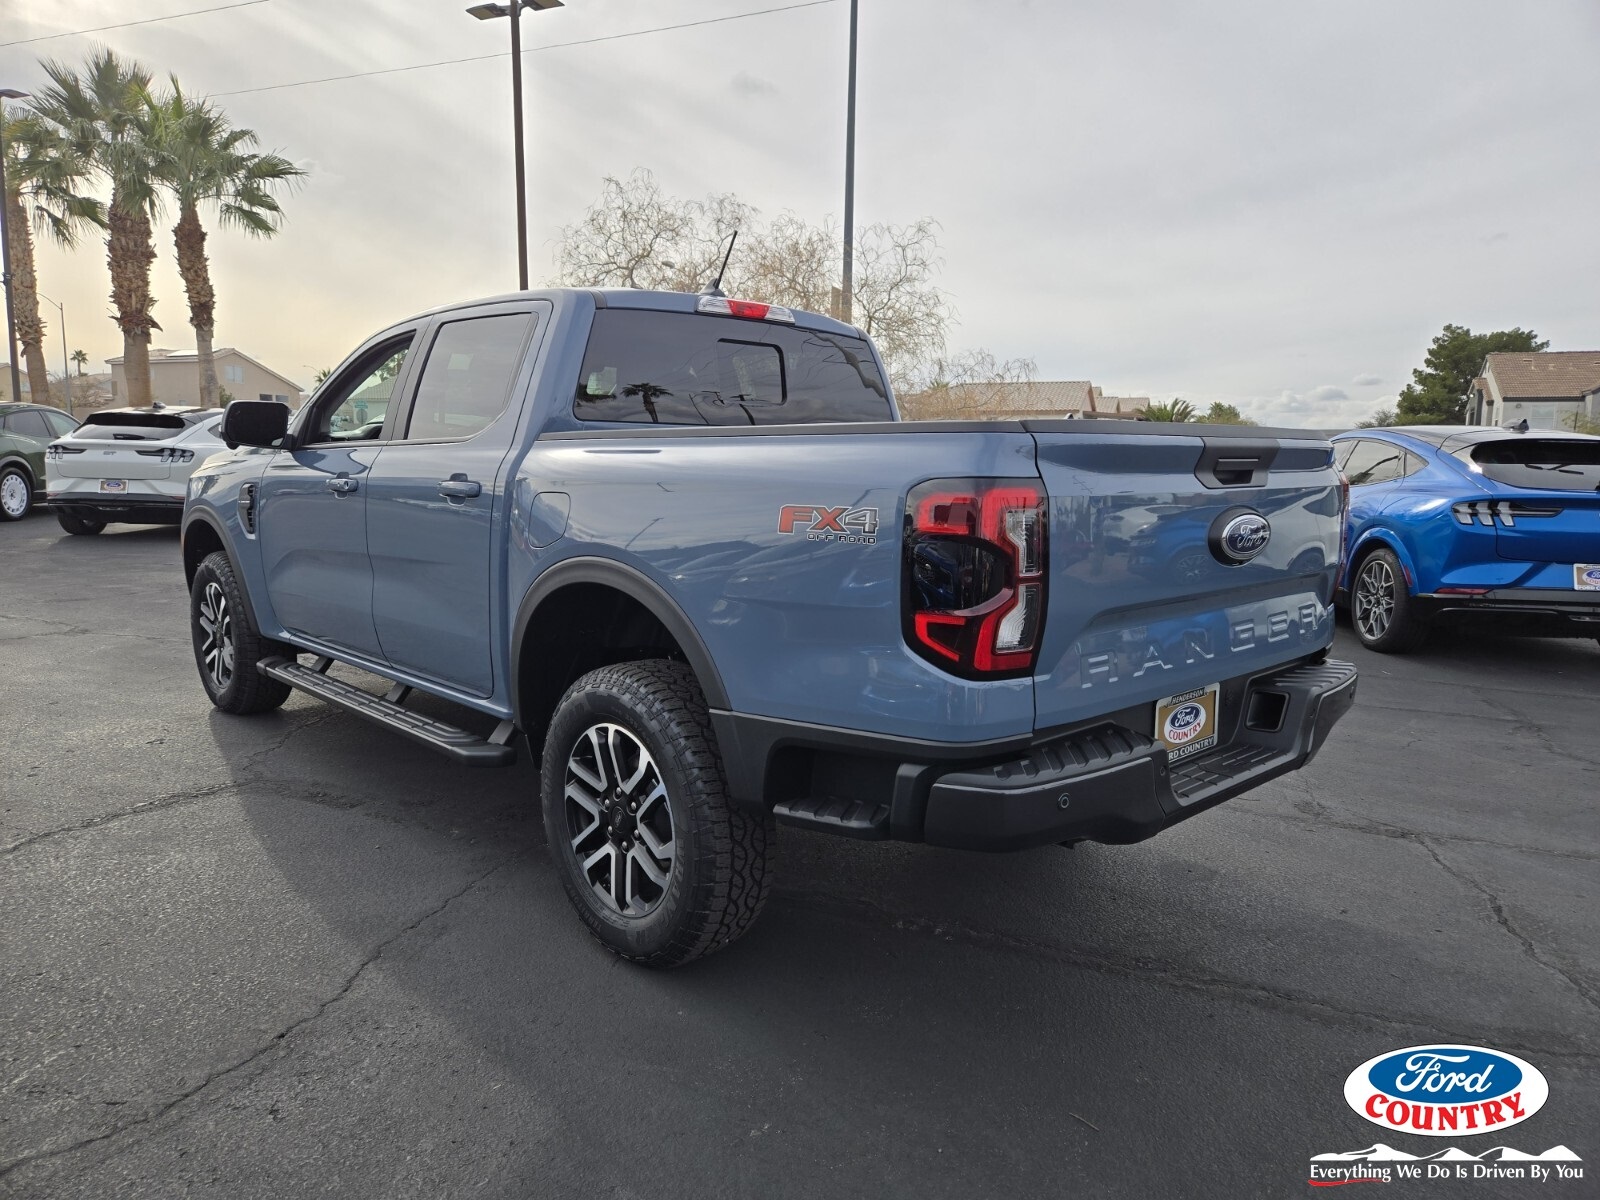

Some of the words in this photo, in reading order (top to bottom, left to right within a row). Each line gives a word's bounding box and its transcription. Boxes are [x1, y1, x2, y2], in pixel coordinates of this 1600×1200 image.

[777, 503, 879, 535] FX4
[806, 533, 834, 542] OFF
[838, 534, 877, 545] ROAD
[1079, 602, 1320, 689] RANGER
[1172, 688, 1205, 704] HENDERSON
[1174, 708, 1196, 727] Ford
[1169, 723, 1202, 741] COUNTRY
[1168, 750, 1179, 761] RD
[1180, 737, 1214, 755] COUNTRY
